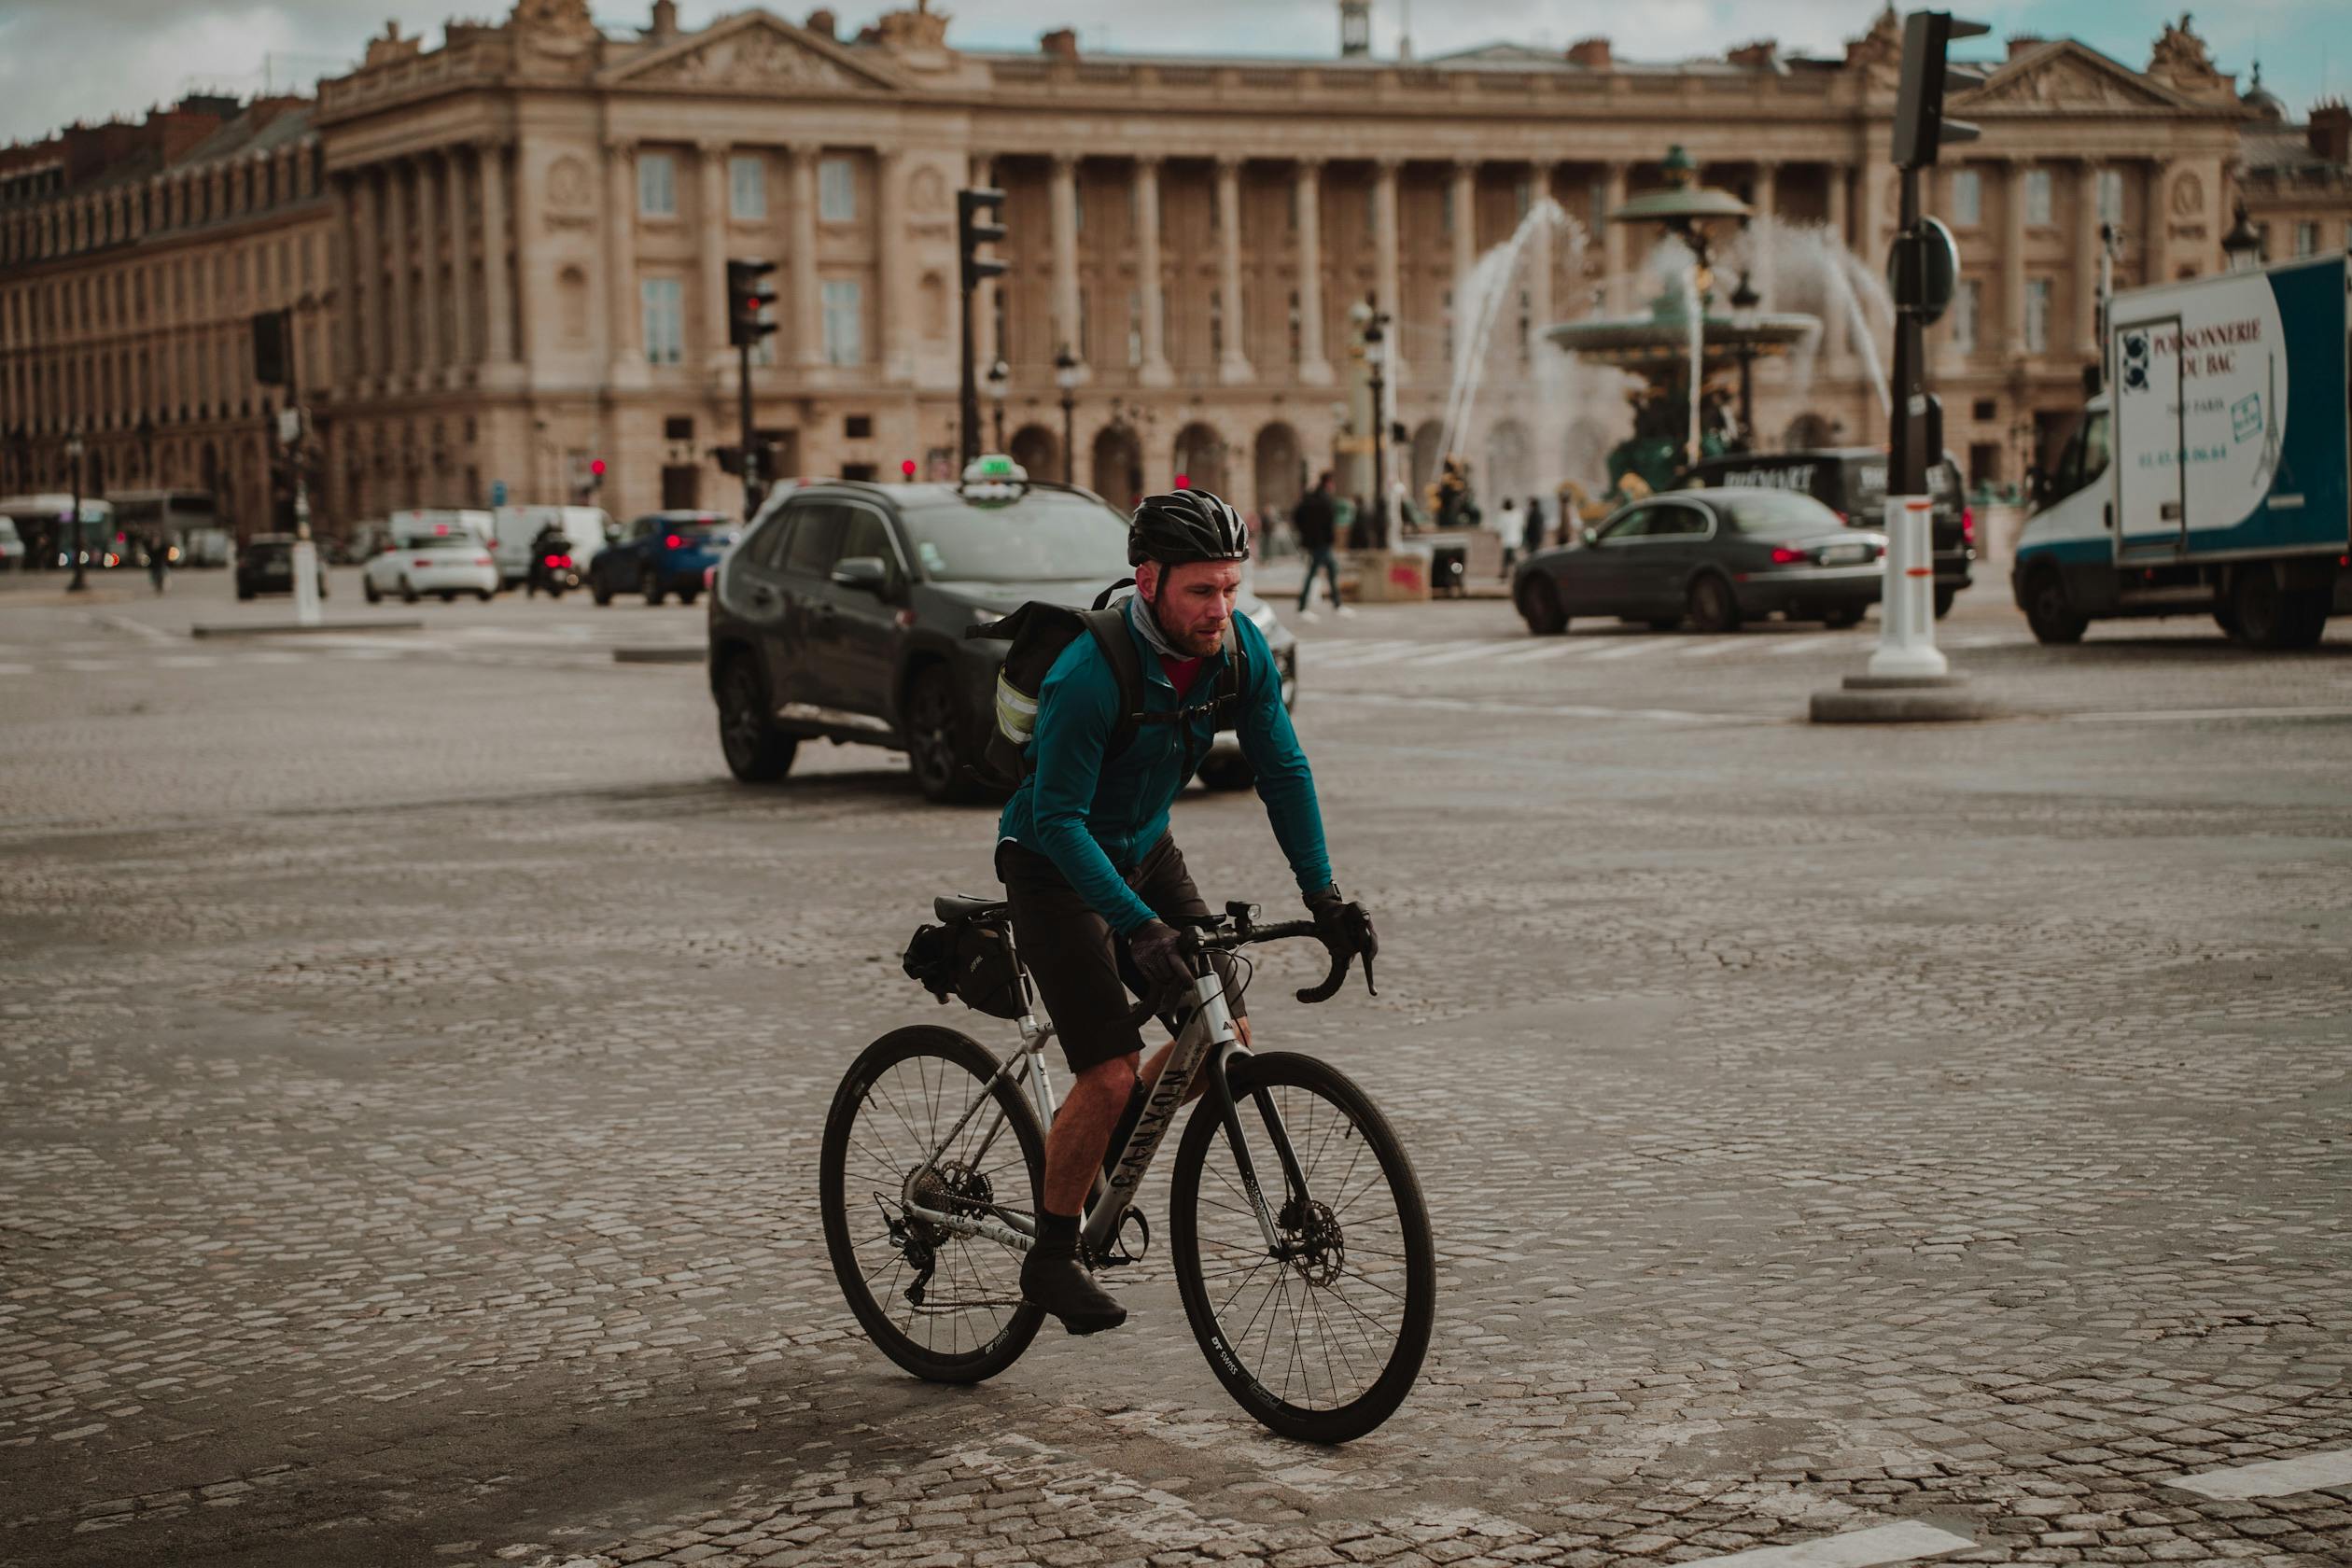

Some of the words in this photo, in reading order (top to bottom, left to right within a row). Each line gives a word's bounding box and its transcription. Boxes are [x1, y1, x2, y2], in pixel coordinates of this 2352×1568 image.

[2154, 320, 2261, 356] POISONNERIE
[2206, 350, 2236, 376] BAC
[1111, 1070, 1187, 1188] CANYON
[985, 1342, 994, 1354] DT
[994, 1328, 1010, 1347] SWISS
[1211, 1336, 1223, 1351] DT
[1219, 1351, 1239, 1375] SWISS
